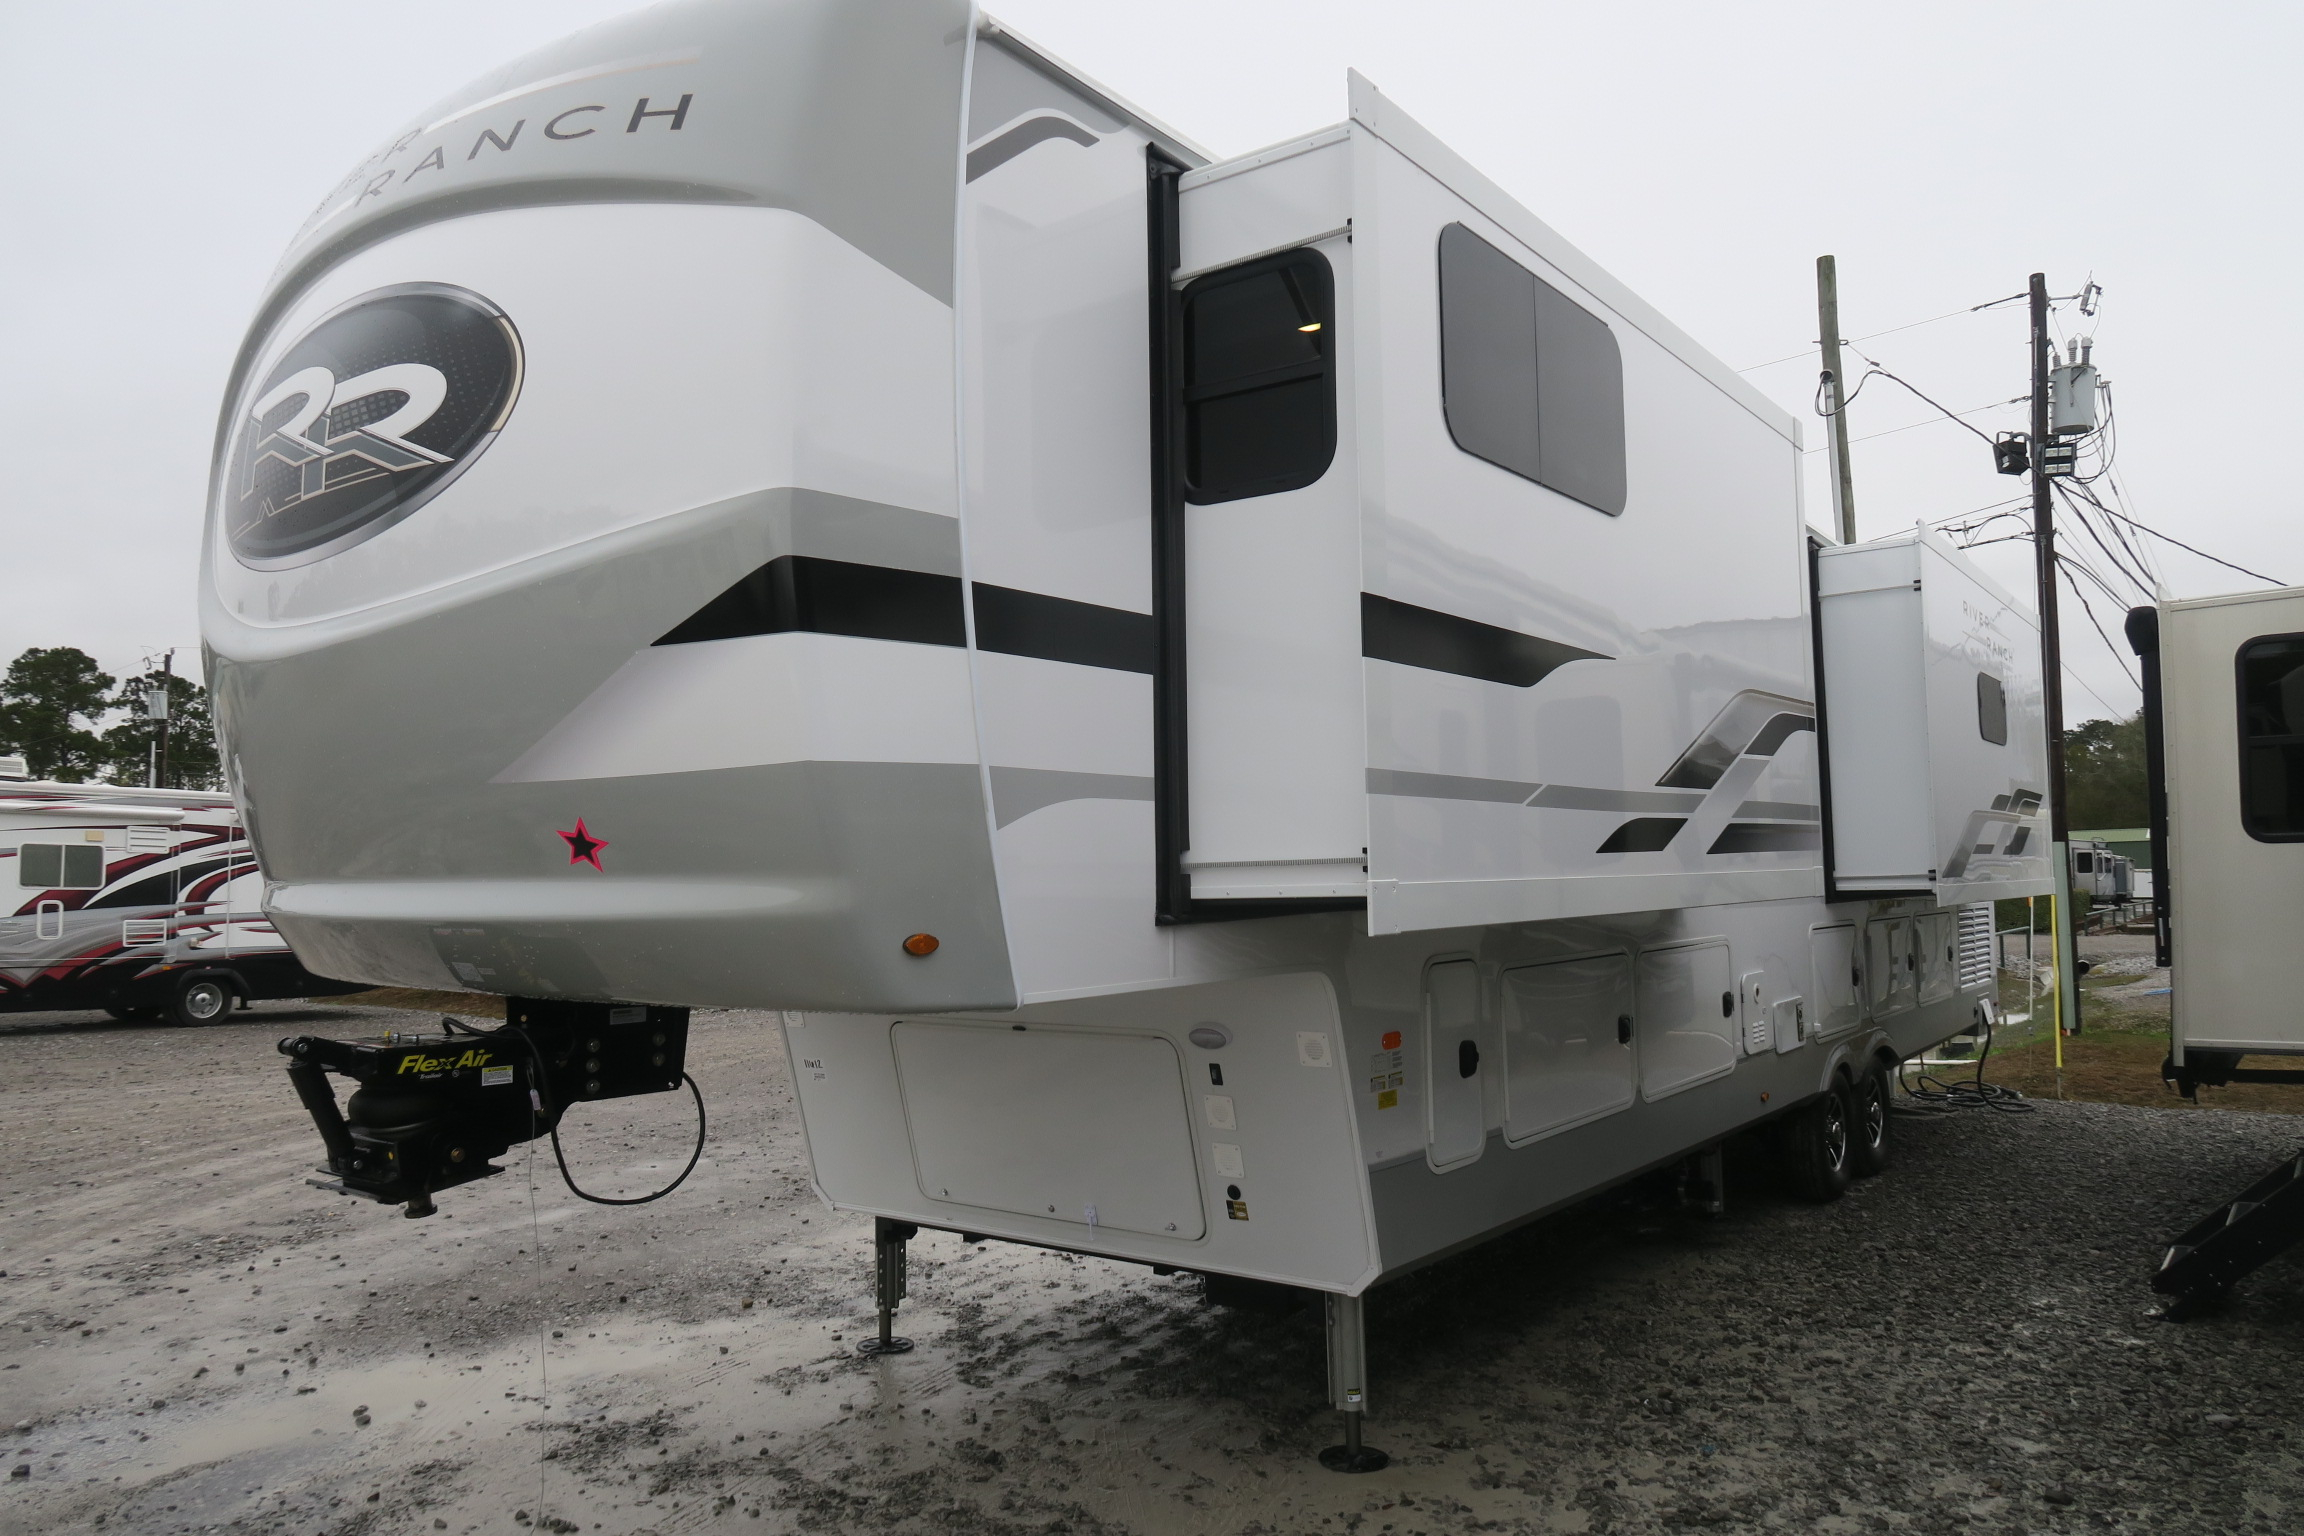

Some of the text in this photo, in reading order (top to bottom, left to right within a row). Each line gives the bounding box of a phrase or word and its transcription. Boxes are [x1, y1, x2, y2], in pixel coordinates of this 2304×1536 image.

[355, 93, 694, 208] RANCH
[1962, 599, 1990, 630] RIVER
[1986, 636, 2014, 664] RANCH
